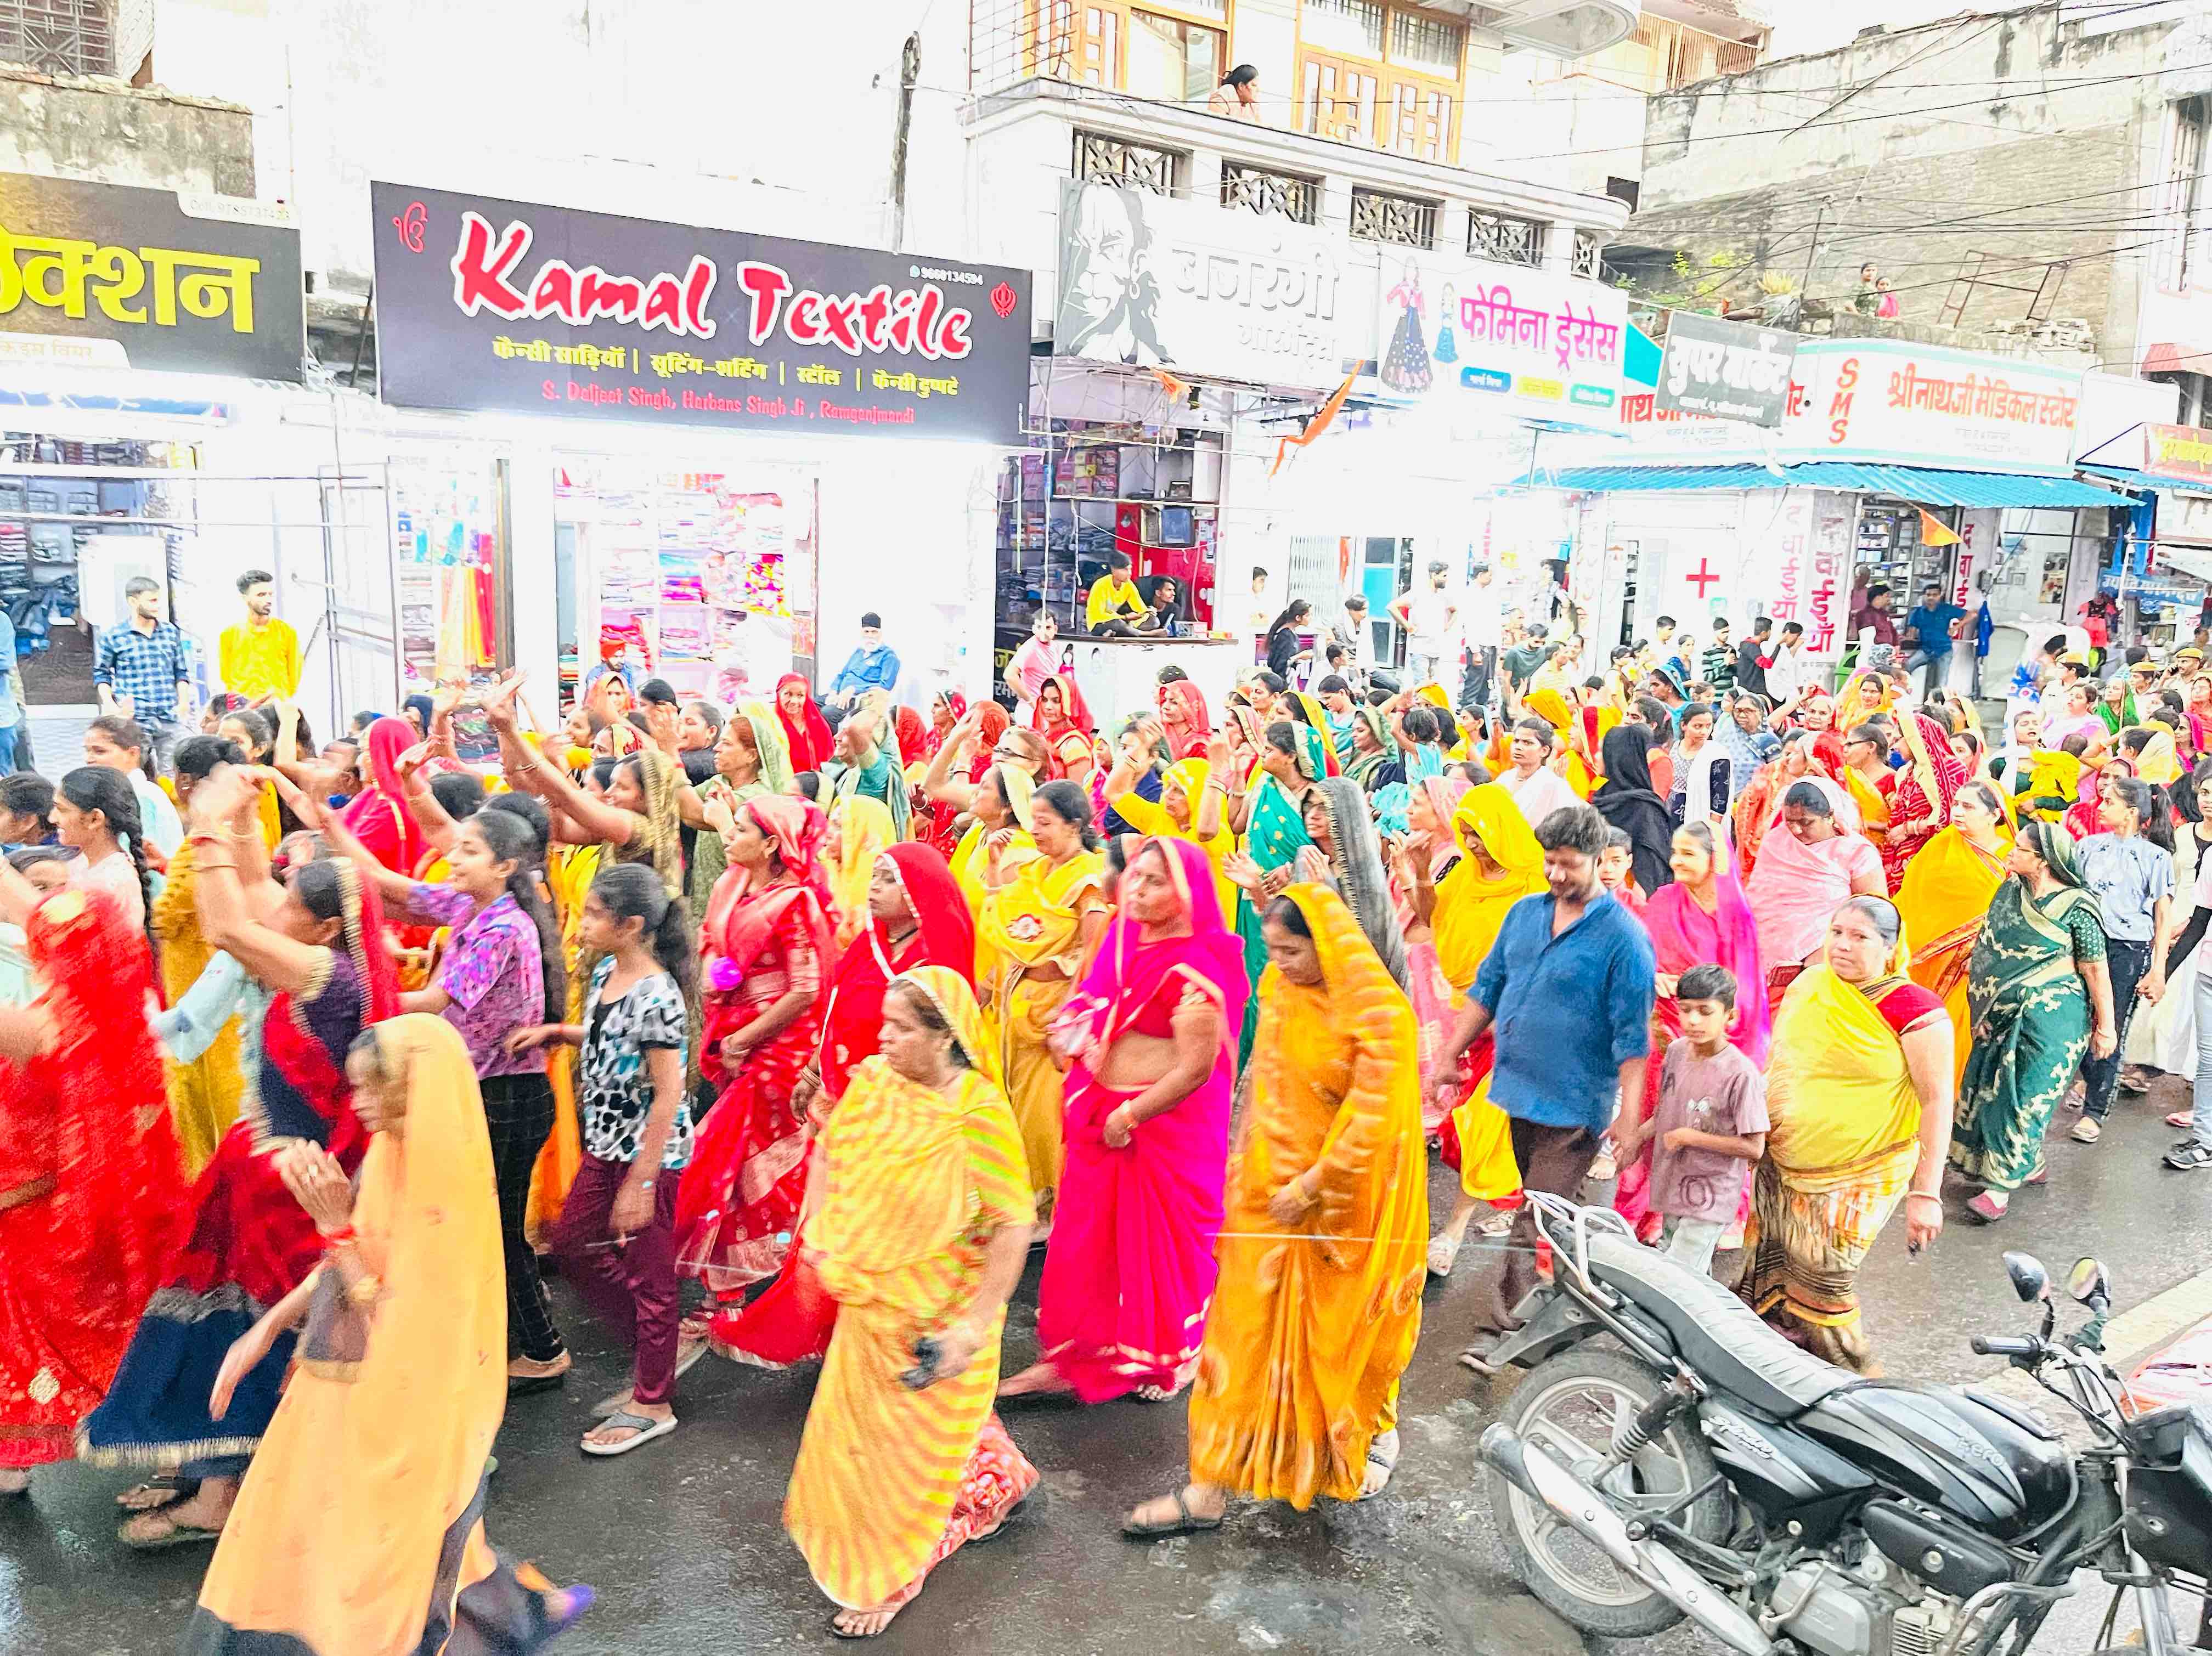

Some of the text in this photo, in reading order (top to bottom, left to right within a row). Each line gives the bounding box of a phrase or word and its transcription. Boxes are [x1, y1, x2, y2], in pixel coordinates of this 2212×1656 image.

[452, 213, 970, 359] Kamal Textile
[1460, 283, 1550, 350] फेमिना
[746, 395, 787, 419] Singh
